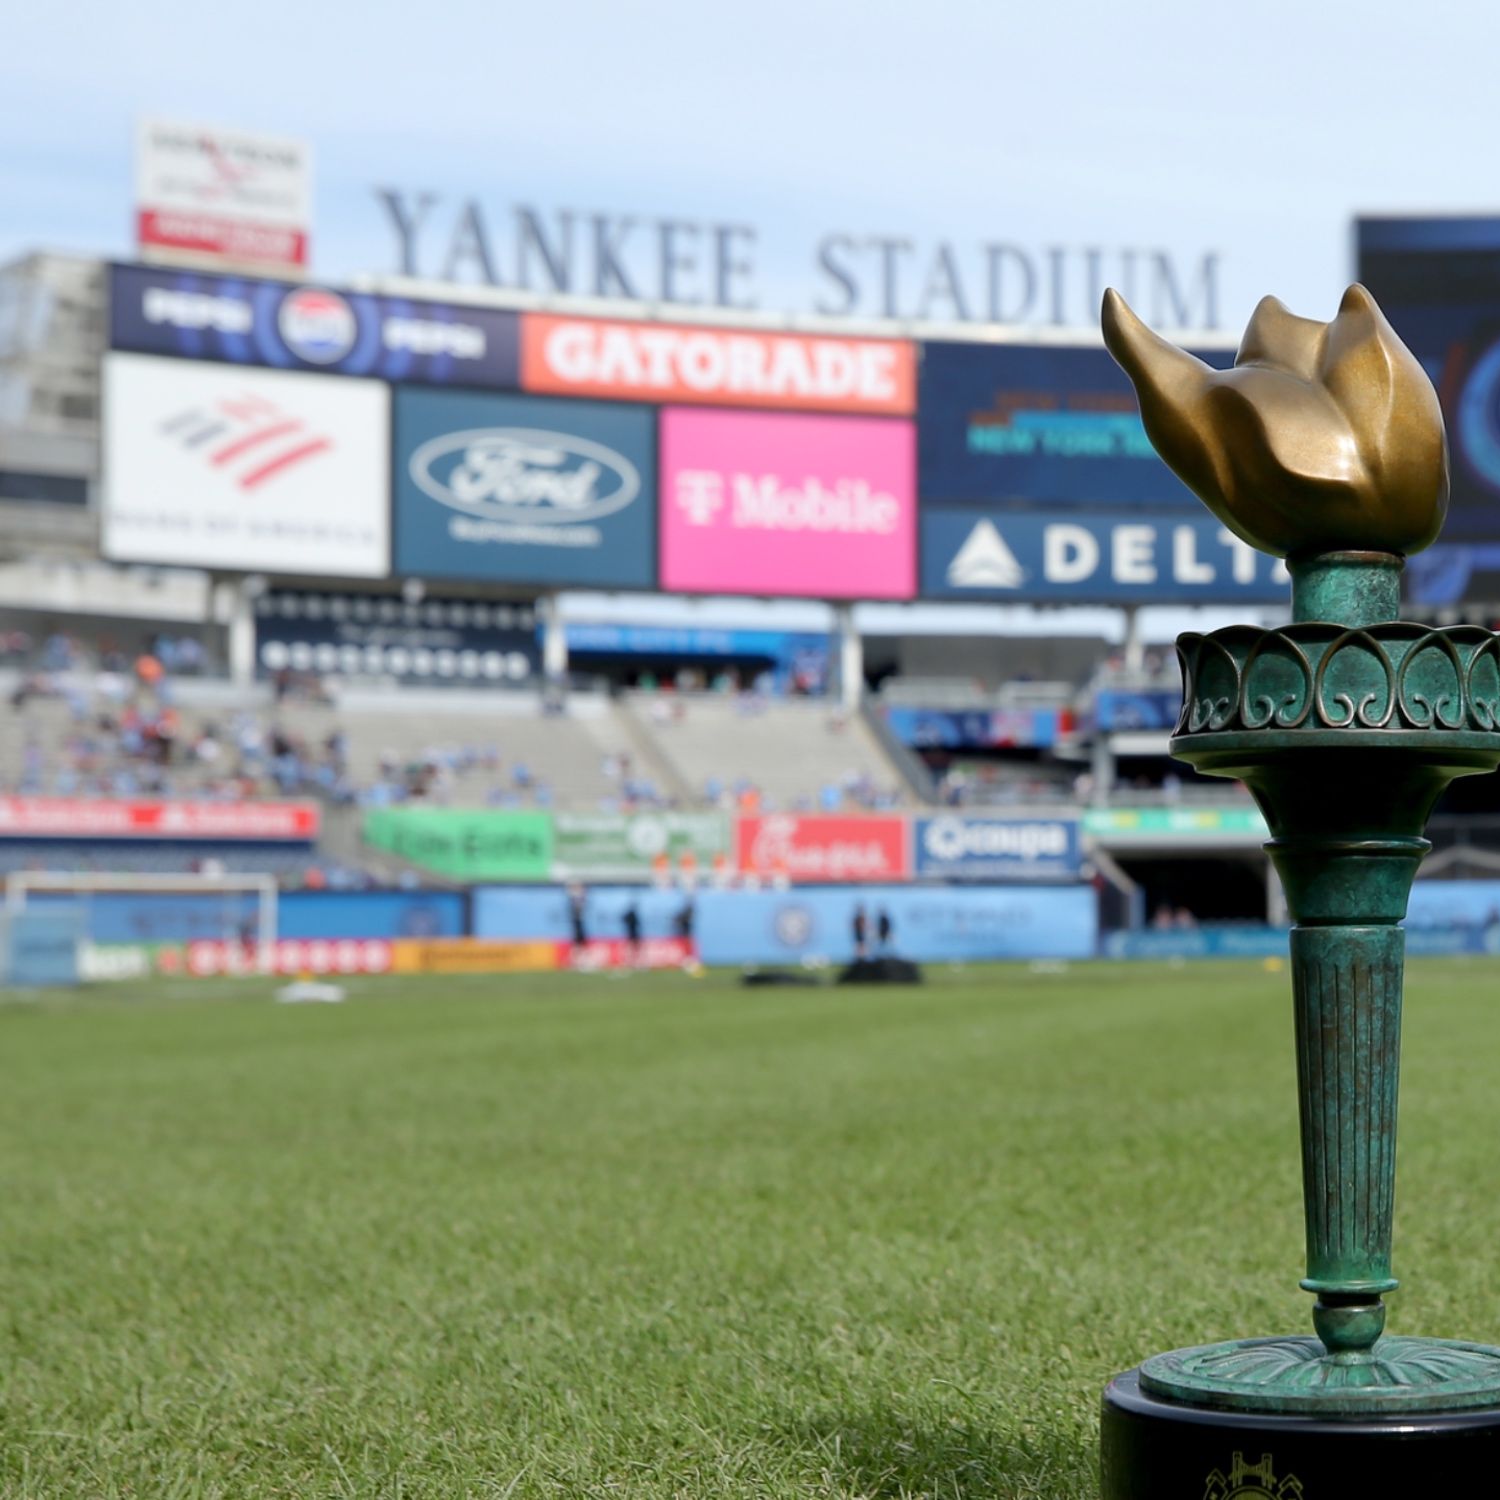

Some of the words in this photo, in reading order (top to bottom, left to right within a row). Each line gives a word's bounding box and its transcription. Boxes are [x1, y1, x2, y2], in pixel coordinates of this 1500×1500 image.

[376, 187, 757, 312] YANKEE
[815, 232, 1224, 330] STADIUM
[546, 322, 898, 399] GATORADE
[450, 438, 602, 511] Ford
[731, 472, 898, 534] Mobile
[1043, 523, 1292, 585] DELT
